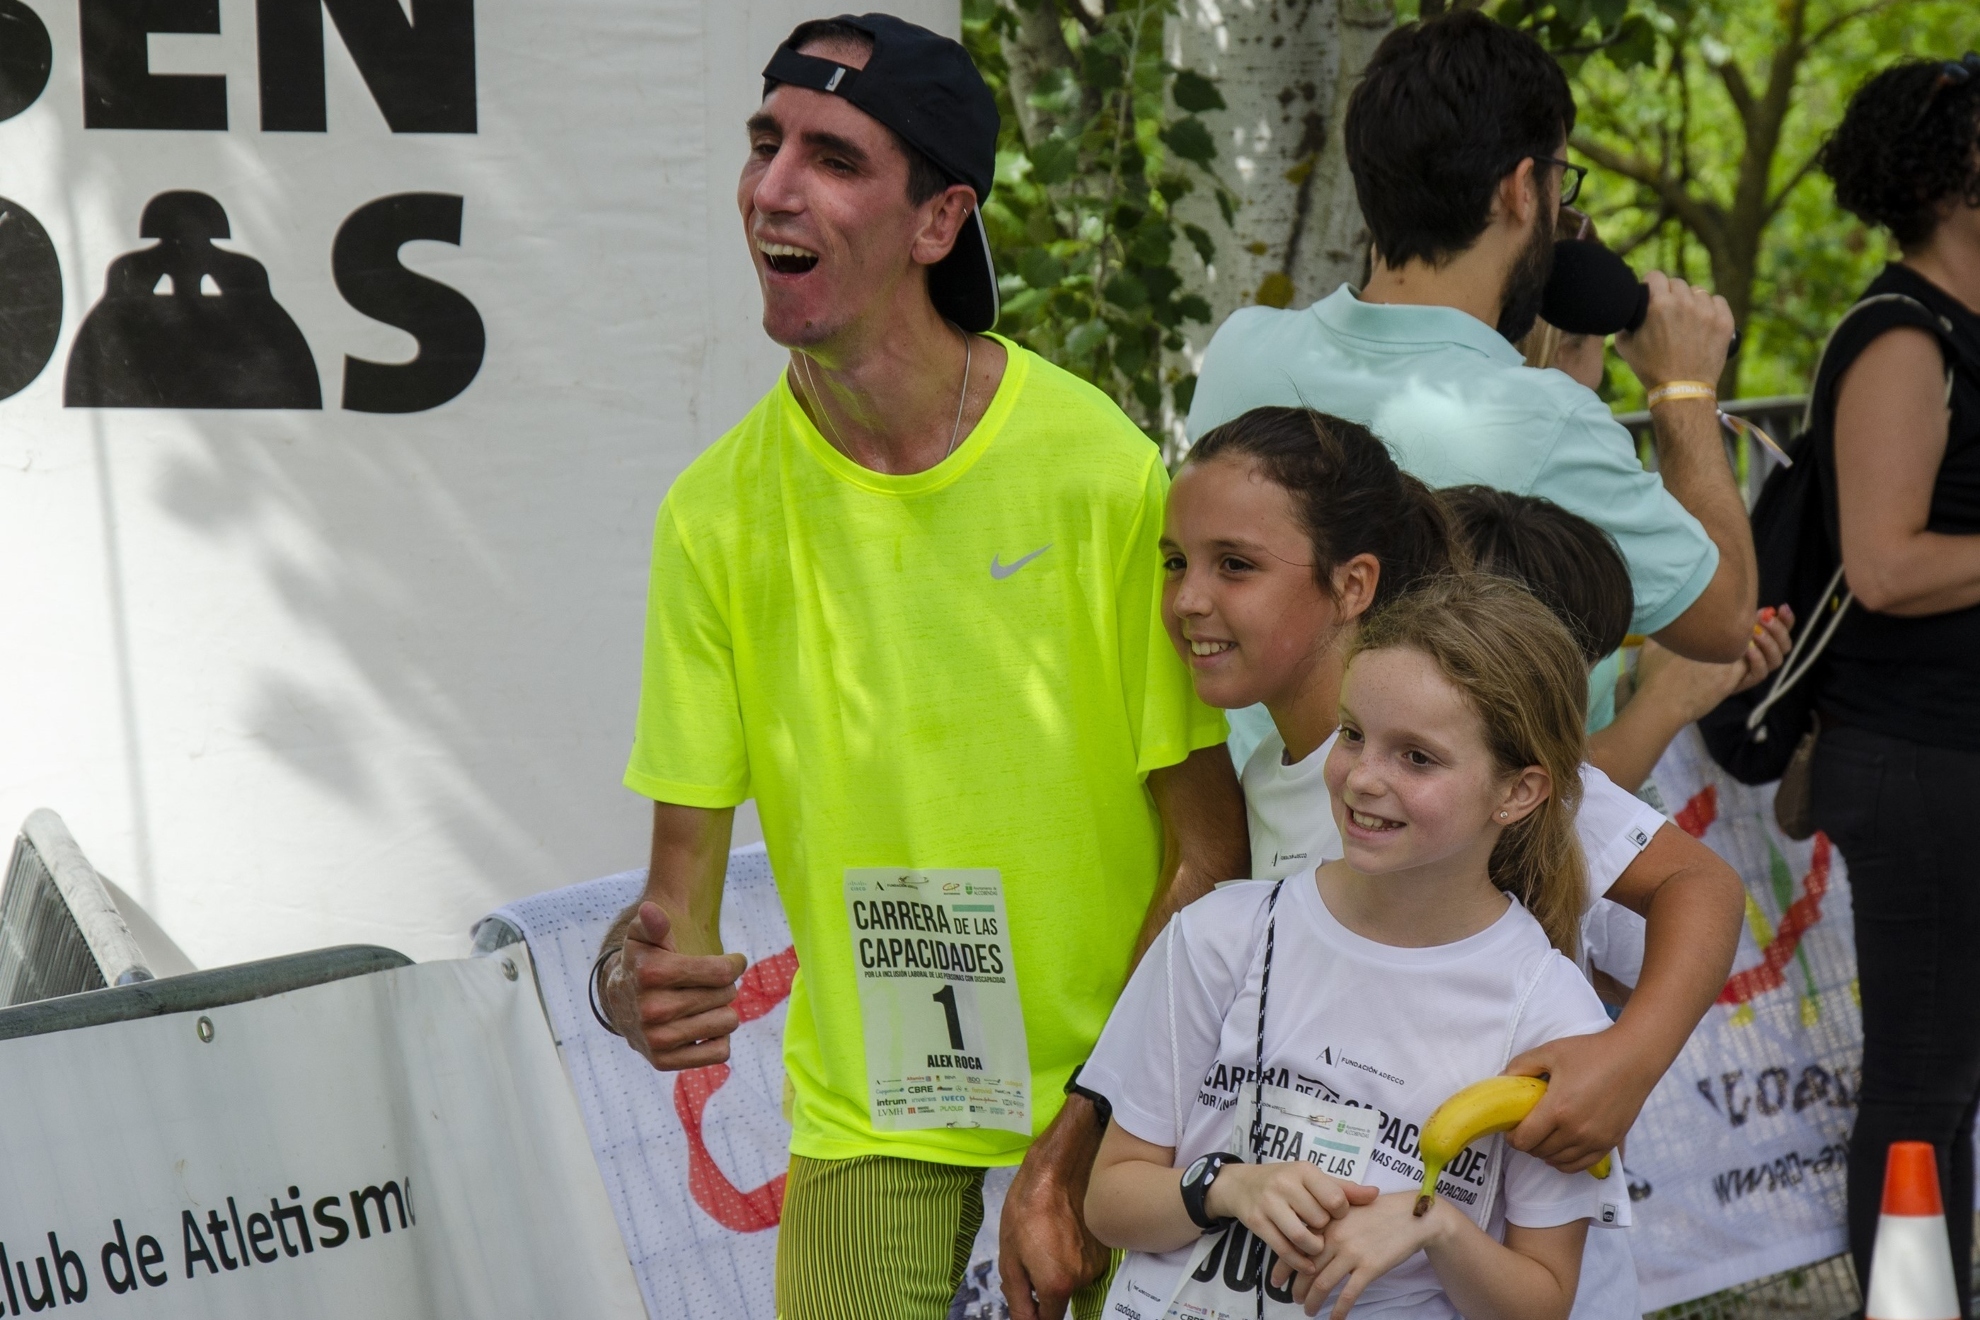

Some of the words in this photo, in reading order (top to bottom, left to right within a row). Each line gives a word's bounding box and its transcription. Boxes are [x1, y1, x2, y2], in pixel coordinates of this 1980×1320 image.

[0, 0, 478, 133] EN
[853, 900, 951, 934] CARRERA
[954, 917, 970, 935] DE
[974, 917, 998, 935] LAS
[859, 938, 1004, 974] CAPACIDADES
[864, 970, 875, 978] POR
[875, 970, 882, 978] LA
[932, 984, 965, 1051] 1
[927, 1054, 953, 1068] ALEX
[955, 1055, 983, 1071] ROCA
[1341, 1057, 1379, 1075] FUNDACIÓN
[1379, 1072, 1405, 1086] ADECCO
[876, 1098, 907, 1107] intrum
[908, 1085, 934, 1094] CBRE
[878, 1107, 904, 1117] LVMH
[1327, 1155, 1356, 1177] LAS
[1391, 1159, 1415, 1178] CON
[1414, 1169, 1478, 1206] DIAPACIDAD
[0, 1230, 88, 1319] lub
[101, 1218, 168, 1295] de
